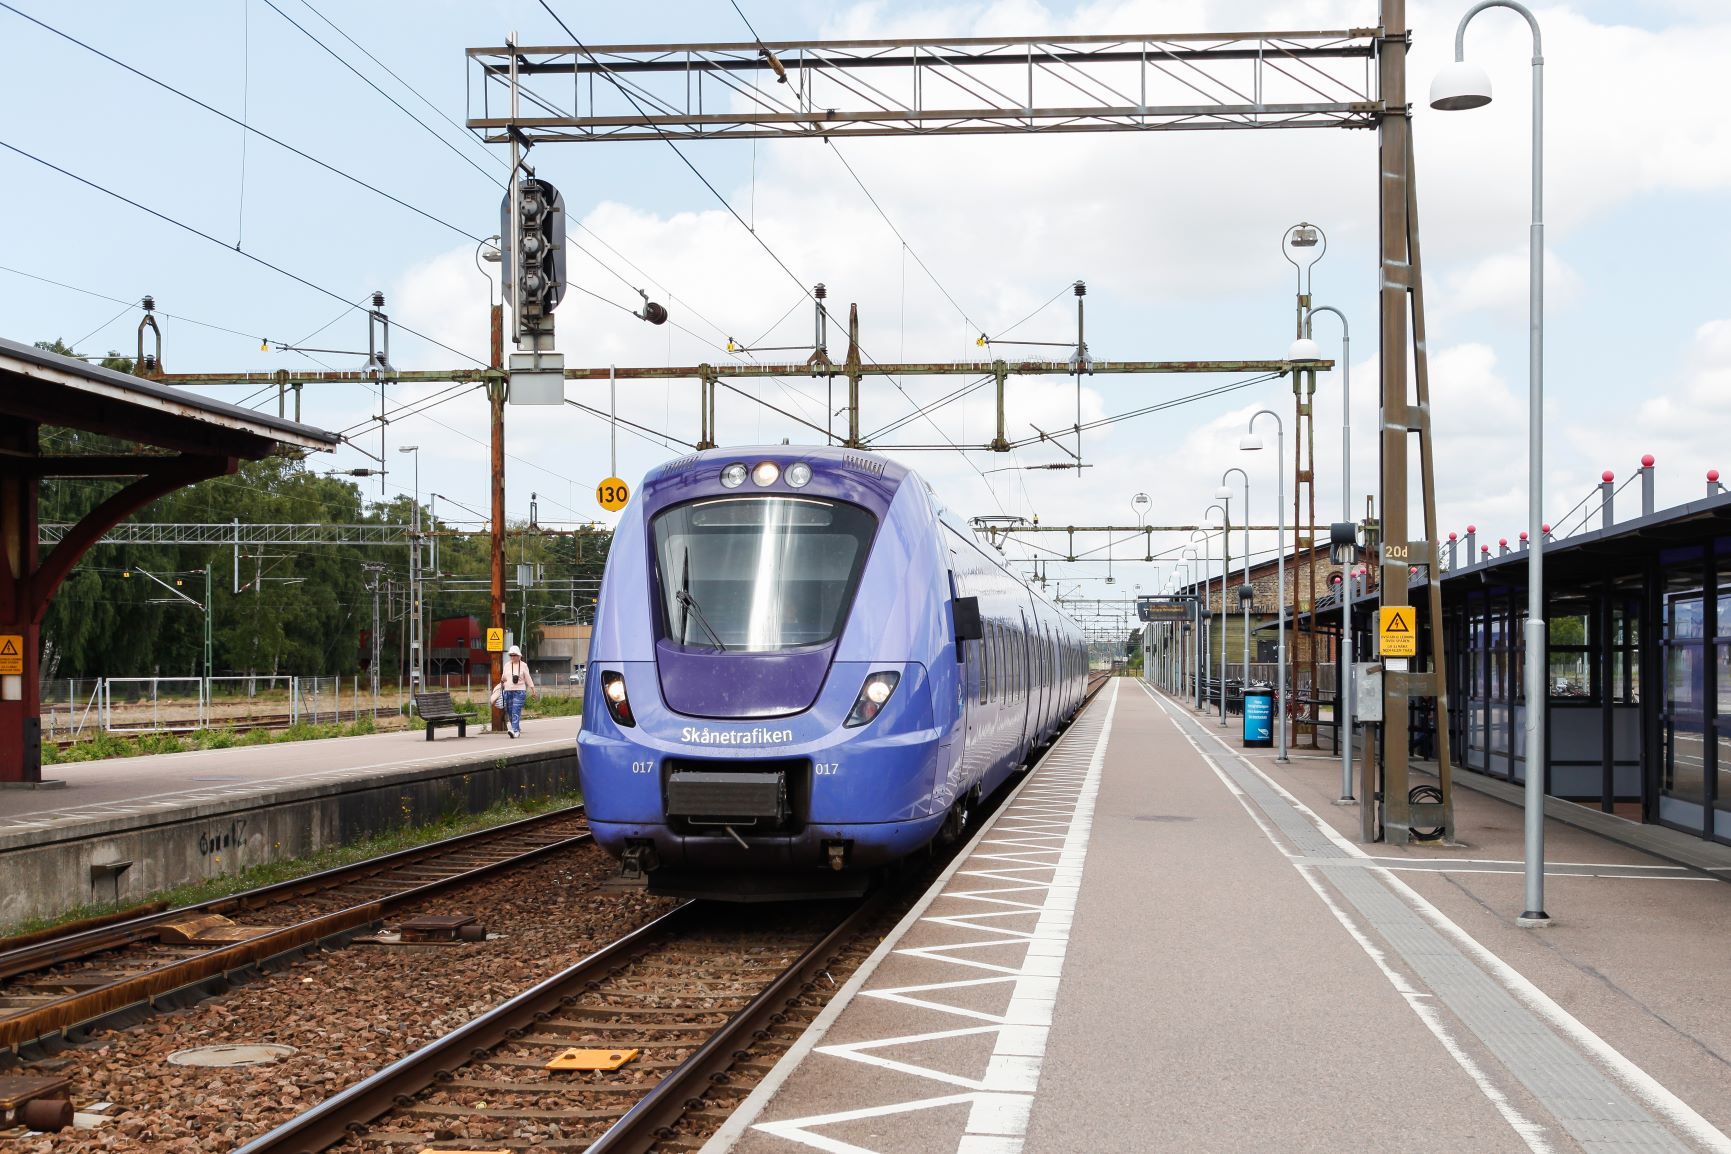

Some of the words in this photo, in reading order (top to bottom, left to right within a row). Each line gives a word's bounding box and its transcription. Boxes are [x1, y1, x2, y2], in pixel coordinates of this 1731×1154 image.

[598, 486, 628, 503] 130
[1385, 545, 1408, 558] 20d
[681, 727, 793, 744] Skånetrafiken
[632, 761, 654, 774] 017
[815, 763, 839, 775] 017
